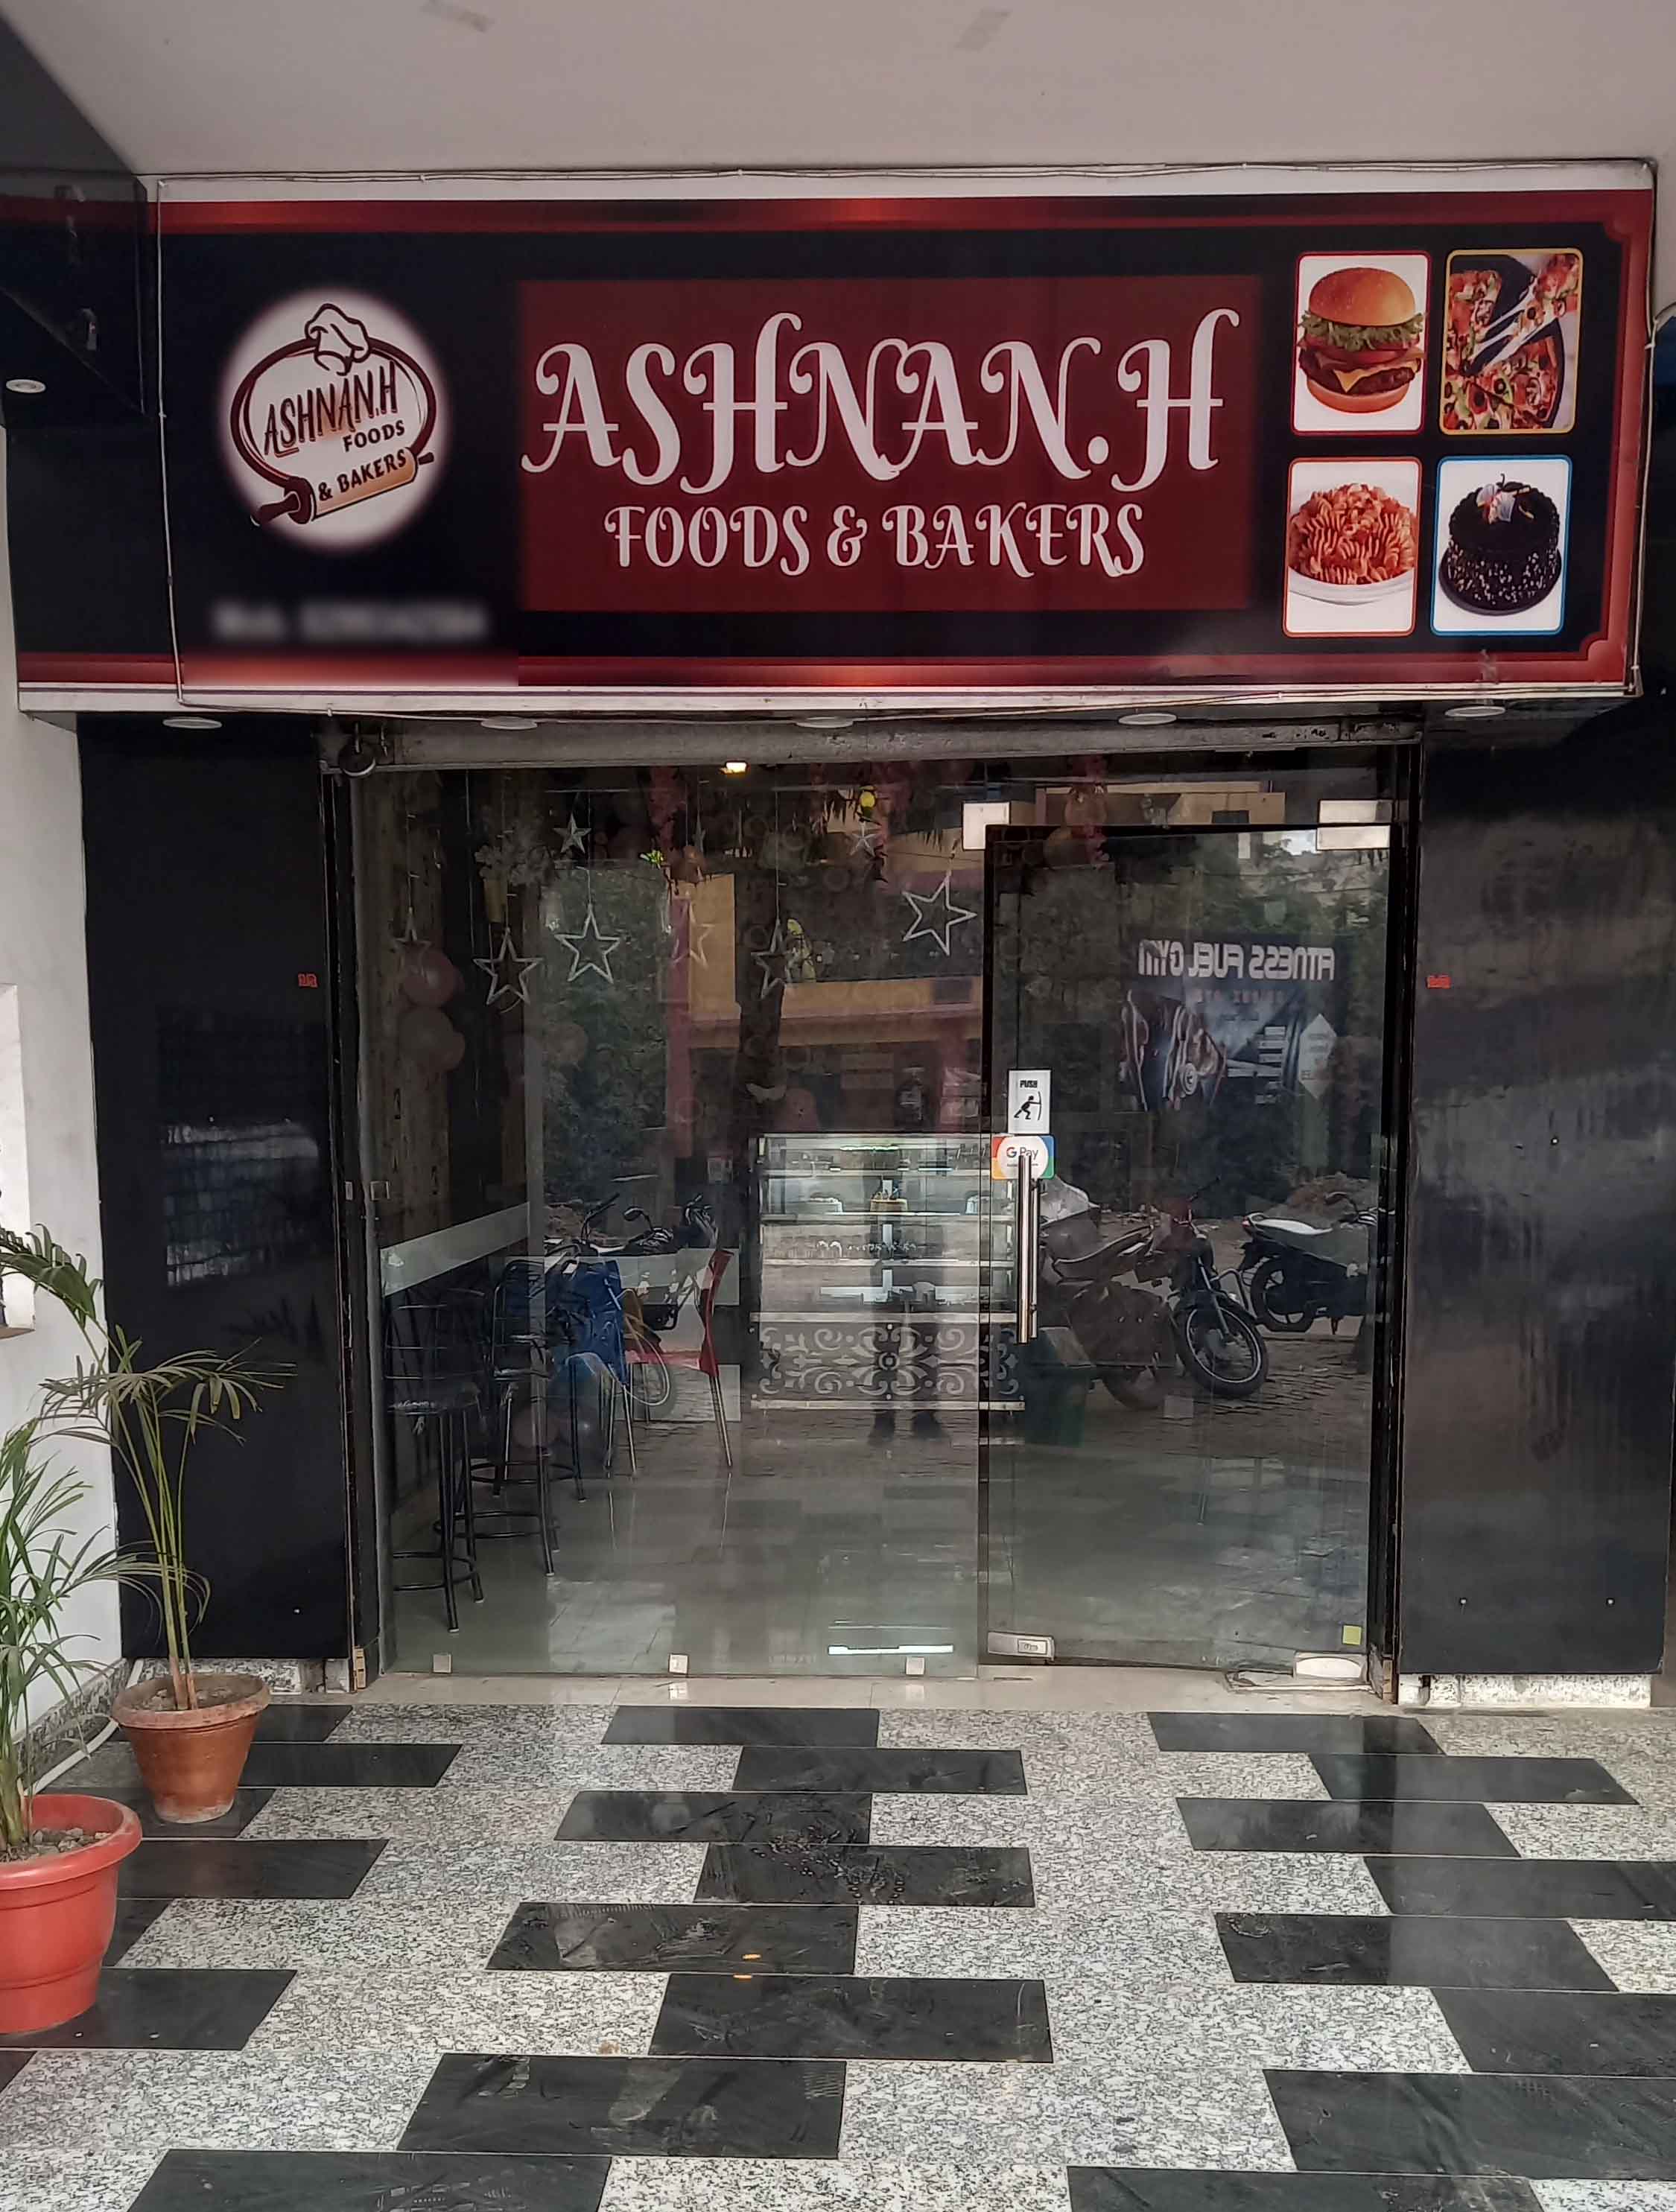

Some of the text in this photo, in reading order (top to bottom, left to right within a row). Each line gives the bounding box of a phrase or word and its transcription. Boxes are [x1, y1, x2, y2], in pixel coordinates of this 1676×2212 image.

[264, 360, 397, 458] ASHNAN.H
[521, 308, 1240, 493] ASHNAN.H
[343, 419, 404, 451] FOODS
[318, 448, 407, 501] & BAKERS
[604, 502, 1144, 578] FOODS & BAKERS
[1006, 1146, 1039, 1160] G Pay
